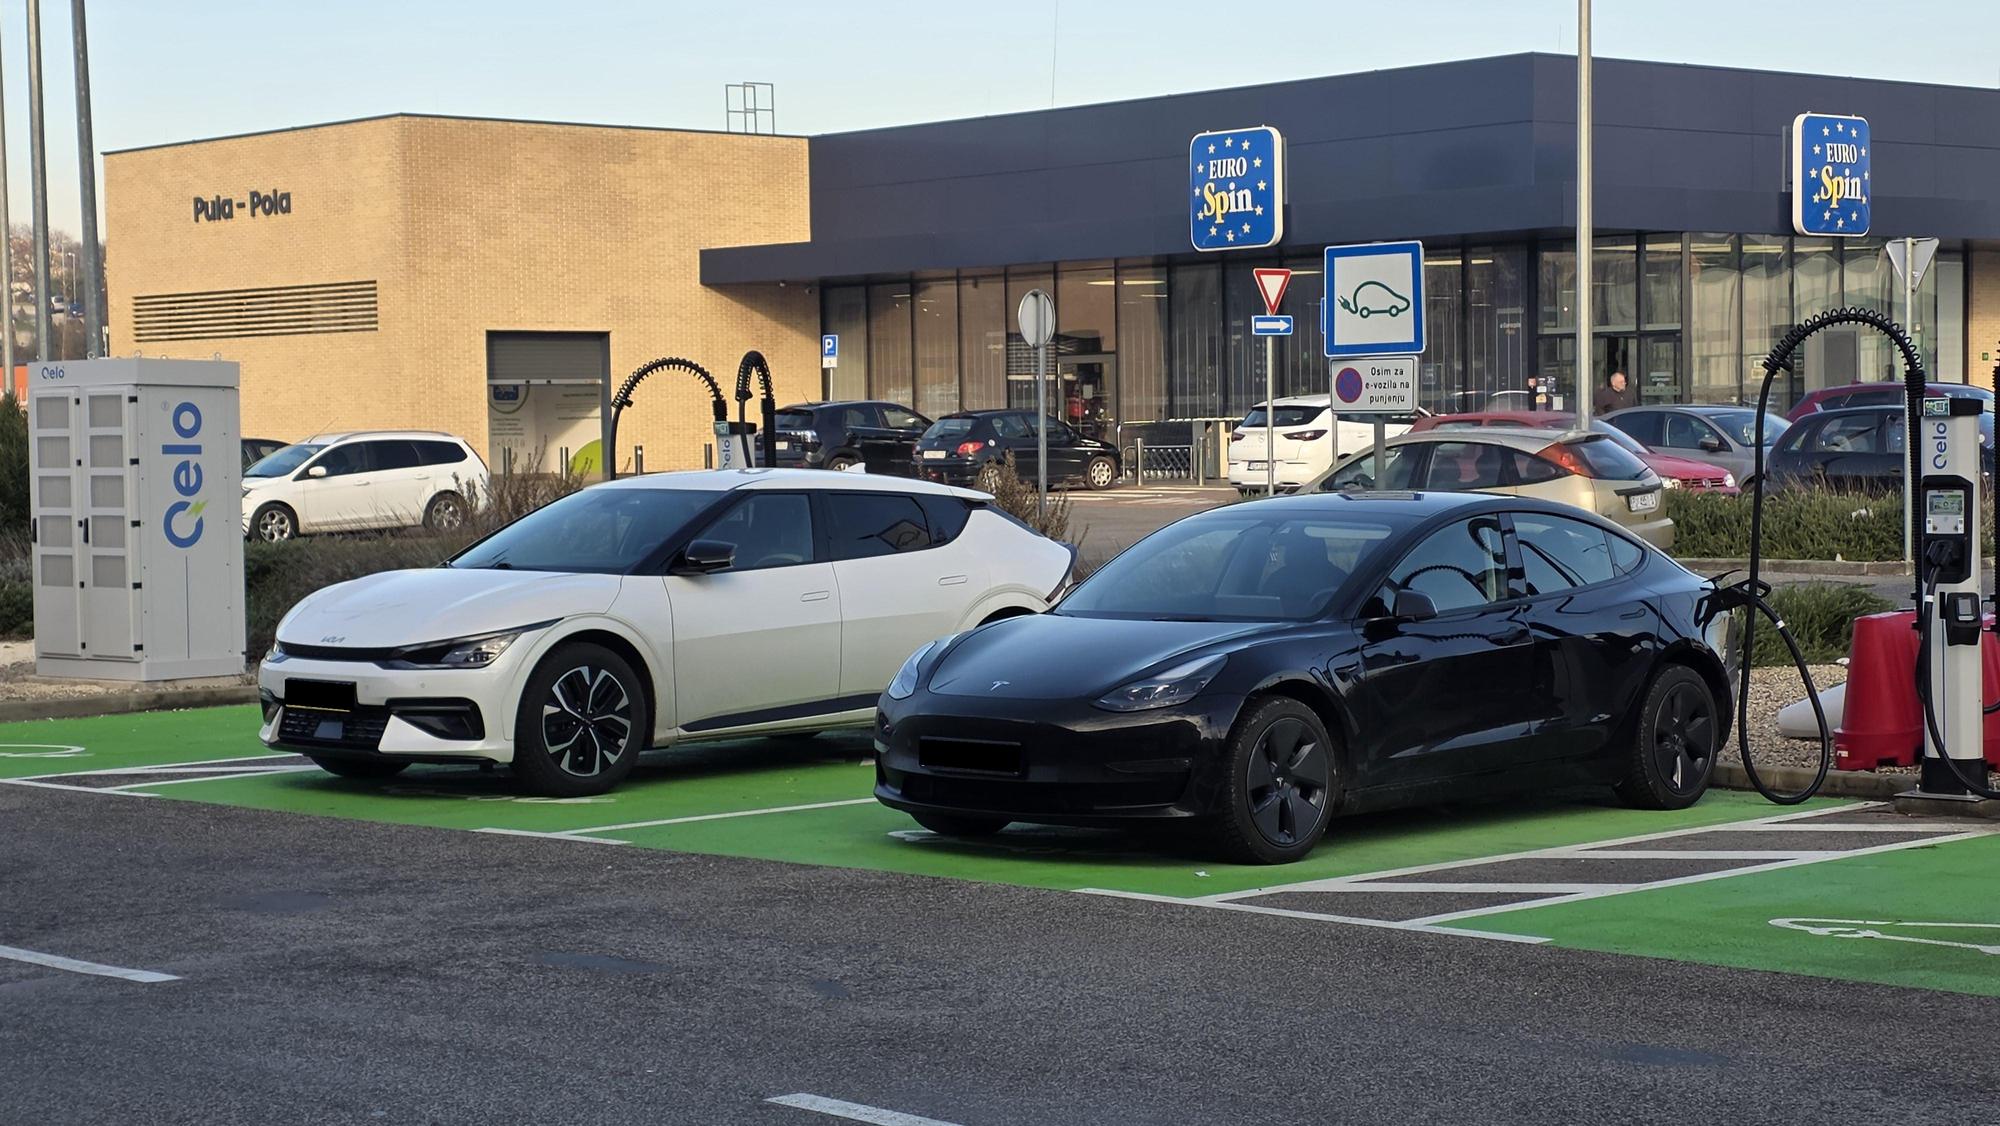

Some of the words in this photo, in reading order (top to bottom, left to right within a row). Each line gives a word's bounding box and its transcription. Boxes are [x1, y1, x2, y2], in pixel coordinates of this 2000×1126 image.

[1826, 143, 1857, 163] EURO
[1209, 156, 1247, 179] EURO
[1820, 165, 1862, 208] Spin
[193, 194, 234, 223] Pula
[249, 188, 291, 217] Pola
[1203, 182, 1253, 223] Spin
[825, 338, 834, 354] P
[41, 366, 65, 380] Qelo
[1370, 366, 1391, 376] Osim
[1394, 368, 1404, 376] za
[1365, 381, 1397, 389] e-vozila
[1400, 381, 1410, 389] na
[1369, 395, 1405, 405] punjenju
